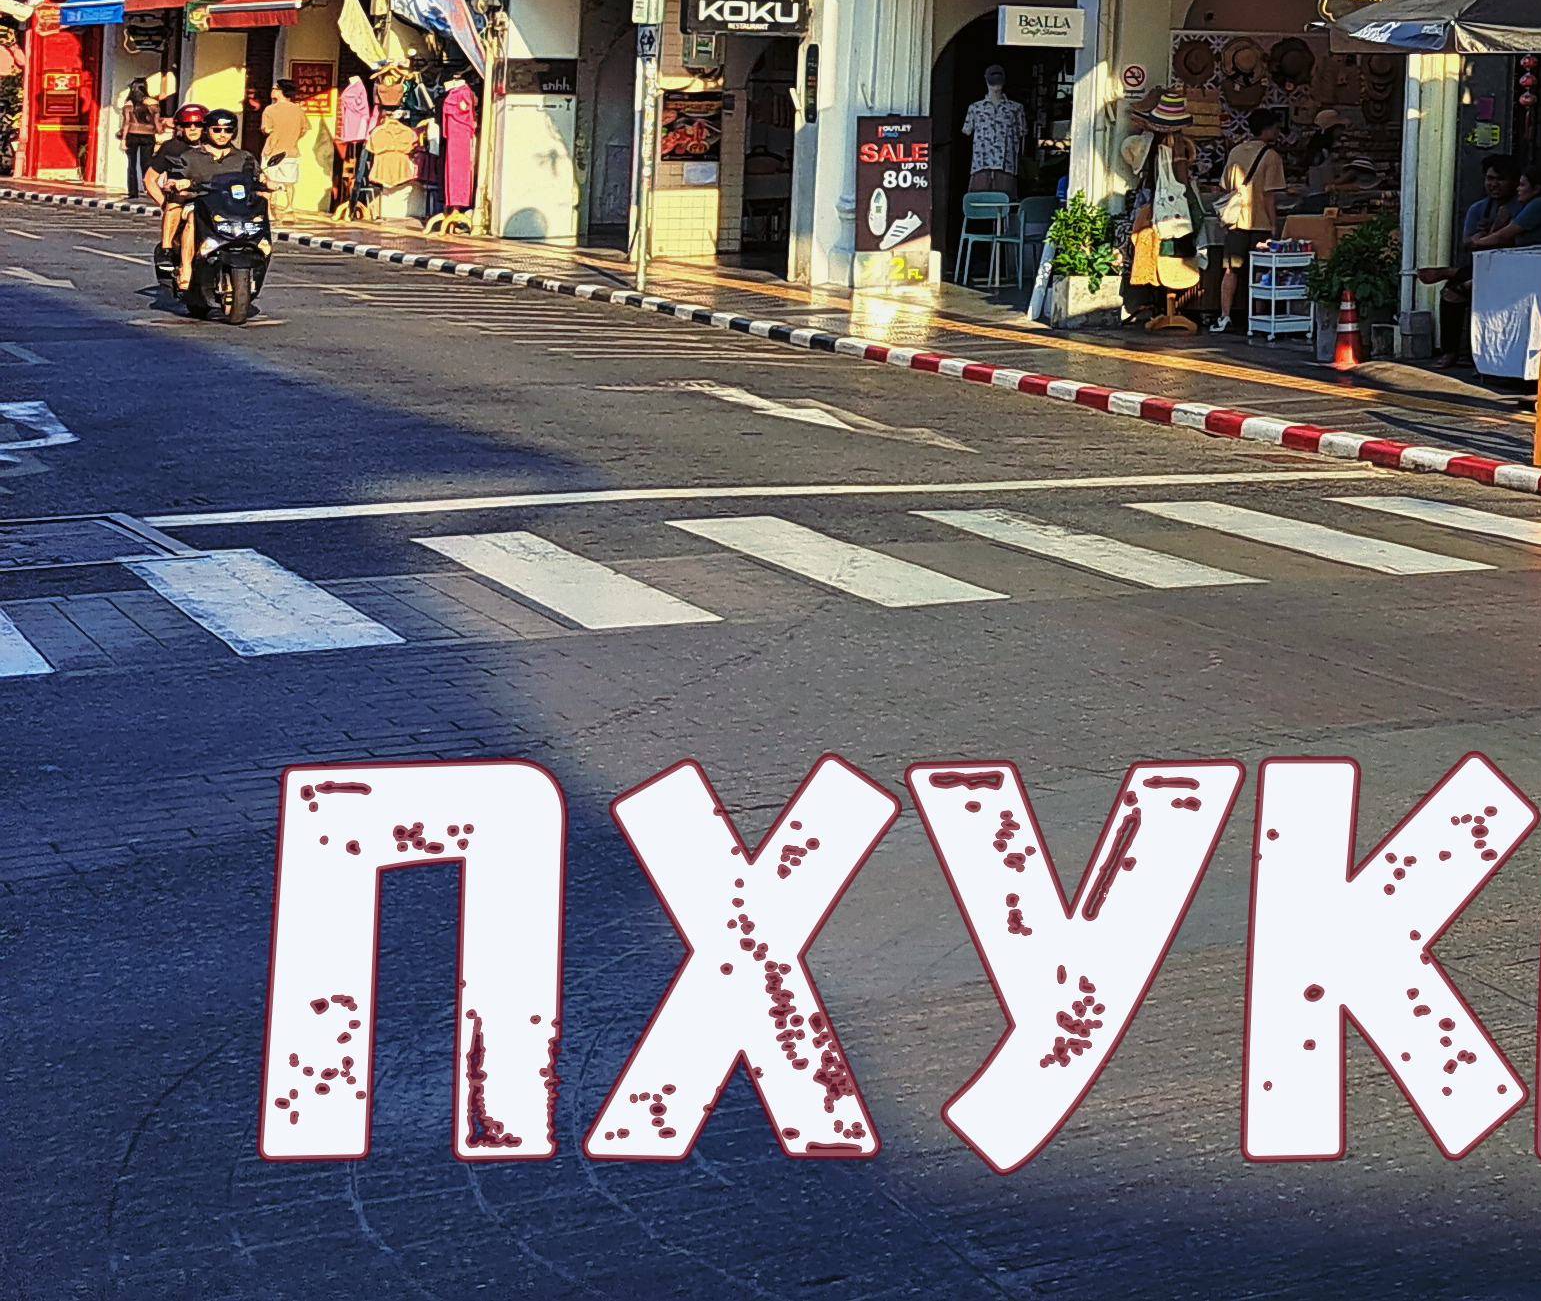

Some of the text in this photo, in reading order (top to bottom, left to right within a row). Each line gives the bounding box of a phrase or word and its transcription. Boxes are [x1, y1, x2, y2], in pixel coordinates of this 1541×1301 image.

[698, 0, 799, 23] KOKU
[1018, 14, 1071, 29] BeALLA
[860, 142, 929, 163] SALE
[901, 162, 928, 170] UP TO
[882, 170, 928, 189] 80%
